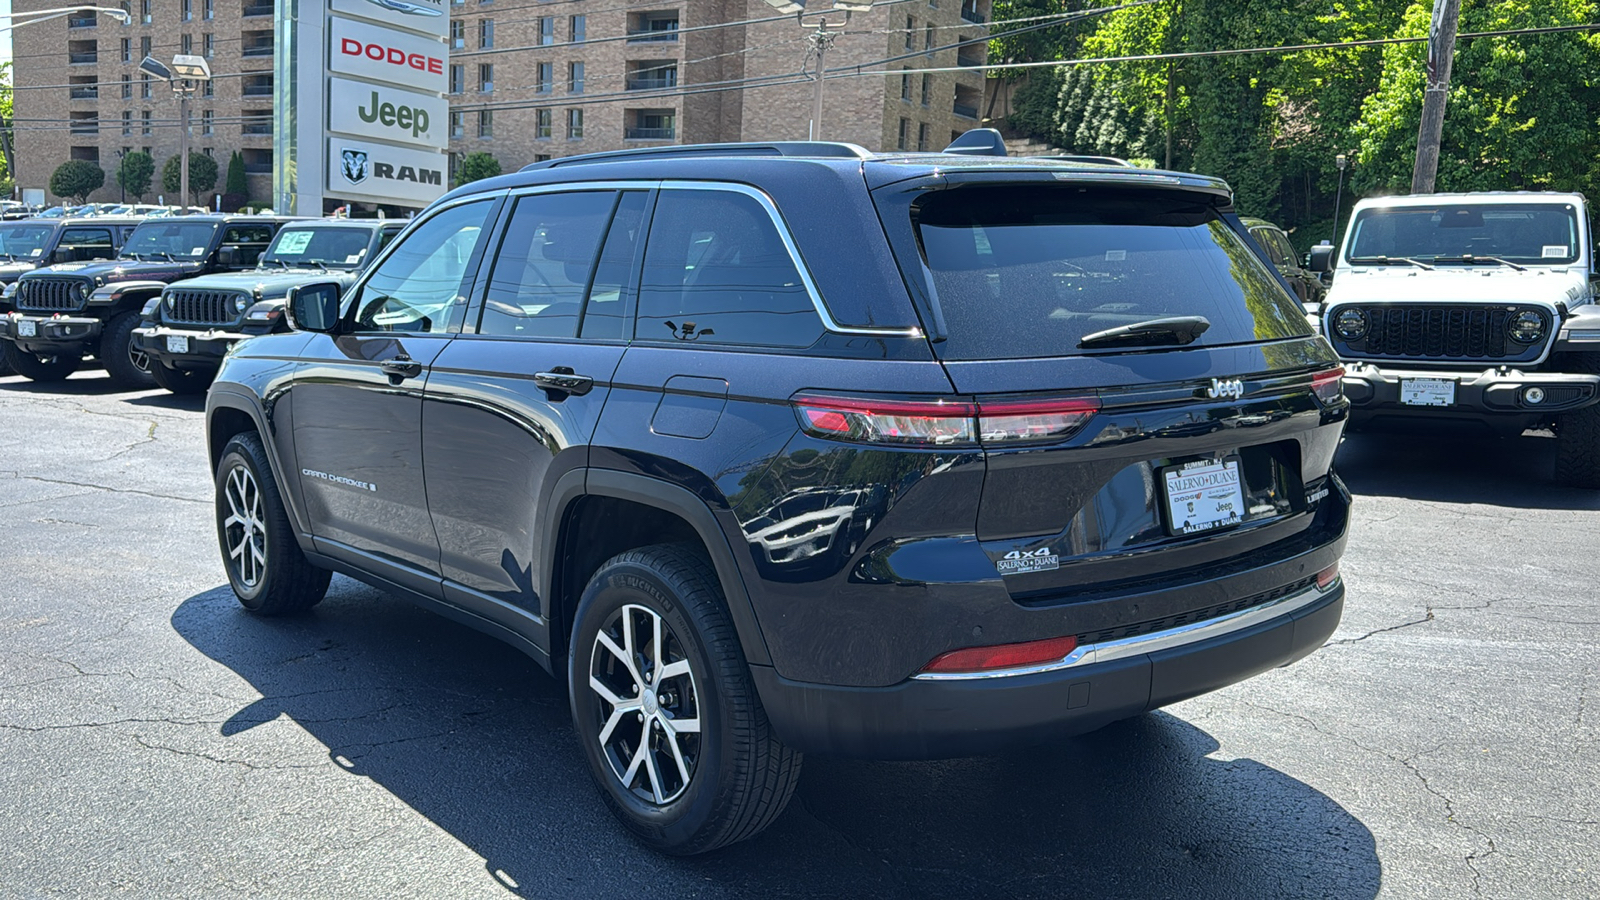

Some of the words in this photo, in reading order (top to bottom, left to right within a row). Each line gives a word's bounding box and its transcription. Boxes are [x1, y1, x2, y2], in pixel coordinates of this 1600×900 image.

[341, 37, 443, 75] DODGE
[358, 91, 429, 138] Jeep
[374, 162, 442, 186] RAM
[1207, 378, 1244, 399] Jeep
[302, 468, 327, 480] GRAND
[328, 474, 369, 490] CHEROKEE
[1168, 476, 1205, 492] SALERNO
[1209, 471, 1237, 485] DUANE
[1215, 502, 1233, 512] Jeep
[1183, 522, 1213, 534] SALERNO
[1221, 516, 1242, 526] DUANE
[999, 560, 1029, 570] SALERNO
[1034, 557, 1057, 566] DUANE
[1003, 547, 1051, 560] 4x4
[627, 576, 672, 612] MICHELIN
